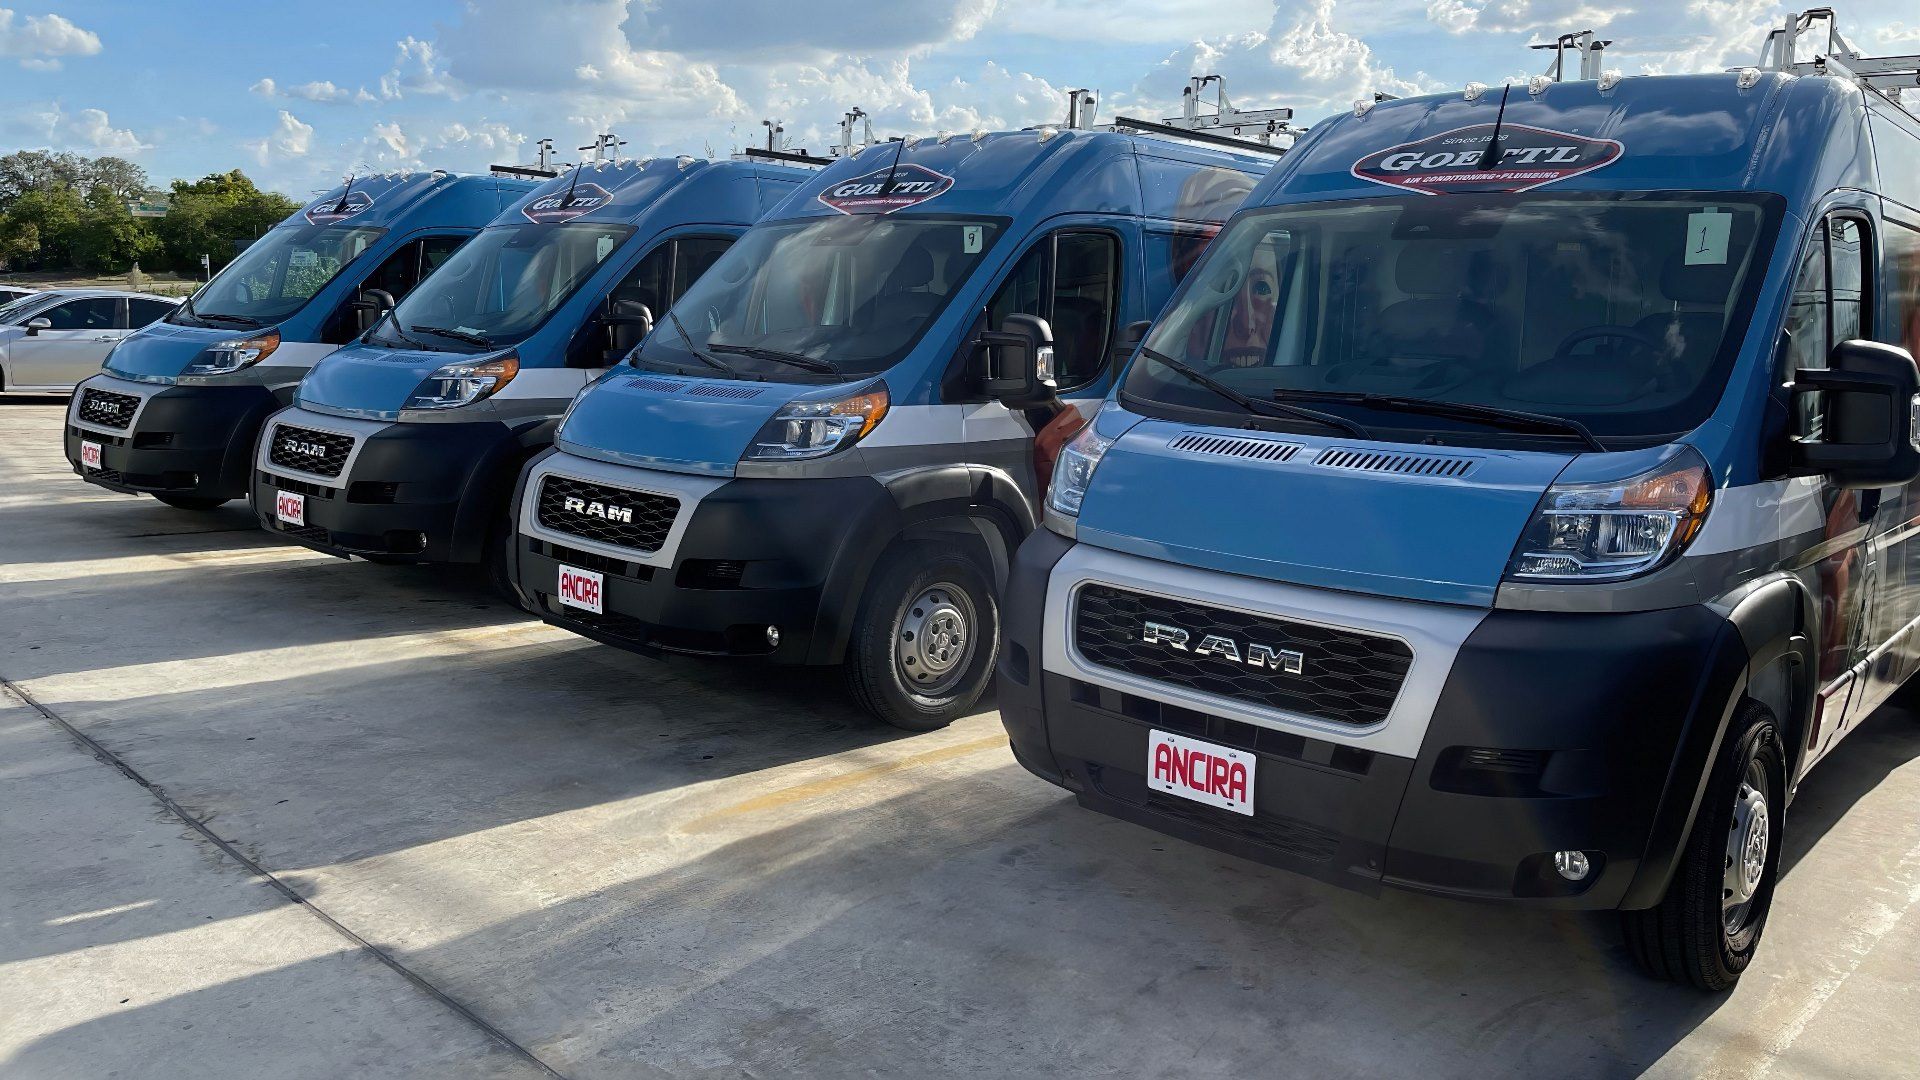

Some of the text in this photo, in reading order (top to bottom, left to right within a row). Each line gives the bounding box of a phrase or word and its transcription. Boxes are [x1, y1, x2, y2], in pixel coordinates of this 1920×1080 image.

[1402, 177, 1423, 185] AIR
[968, 232, 975, 247] 9
[1695, 226, 1710, 254] 1
[284, 439, 325, 457] RAM
[565, 496, 632, 523] RAM
[561, 573, 599, 606] ANCIRA
[1143, 621, 1303, 675] RAM
[1155, 743, 1246, 803] ANCIRA
